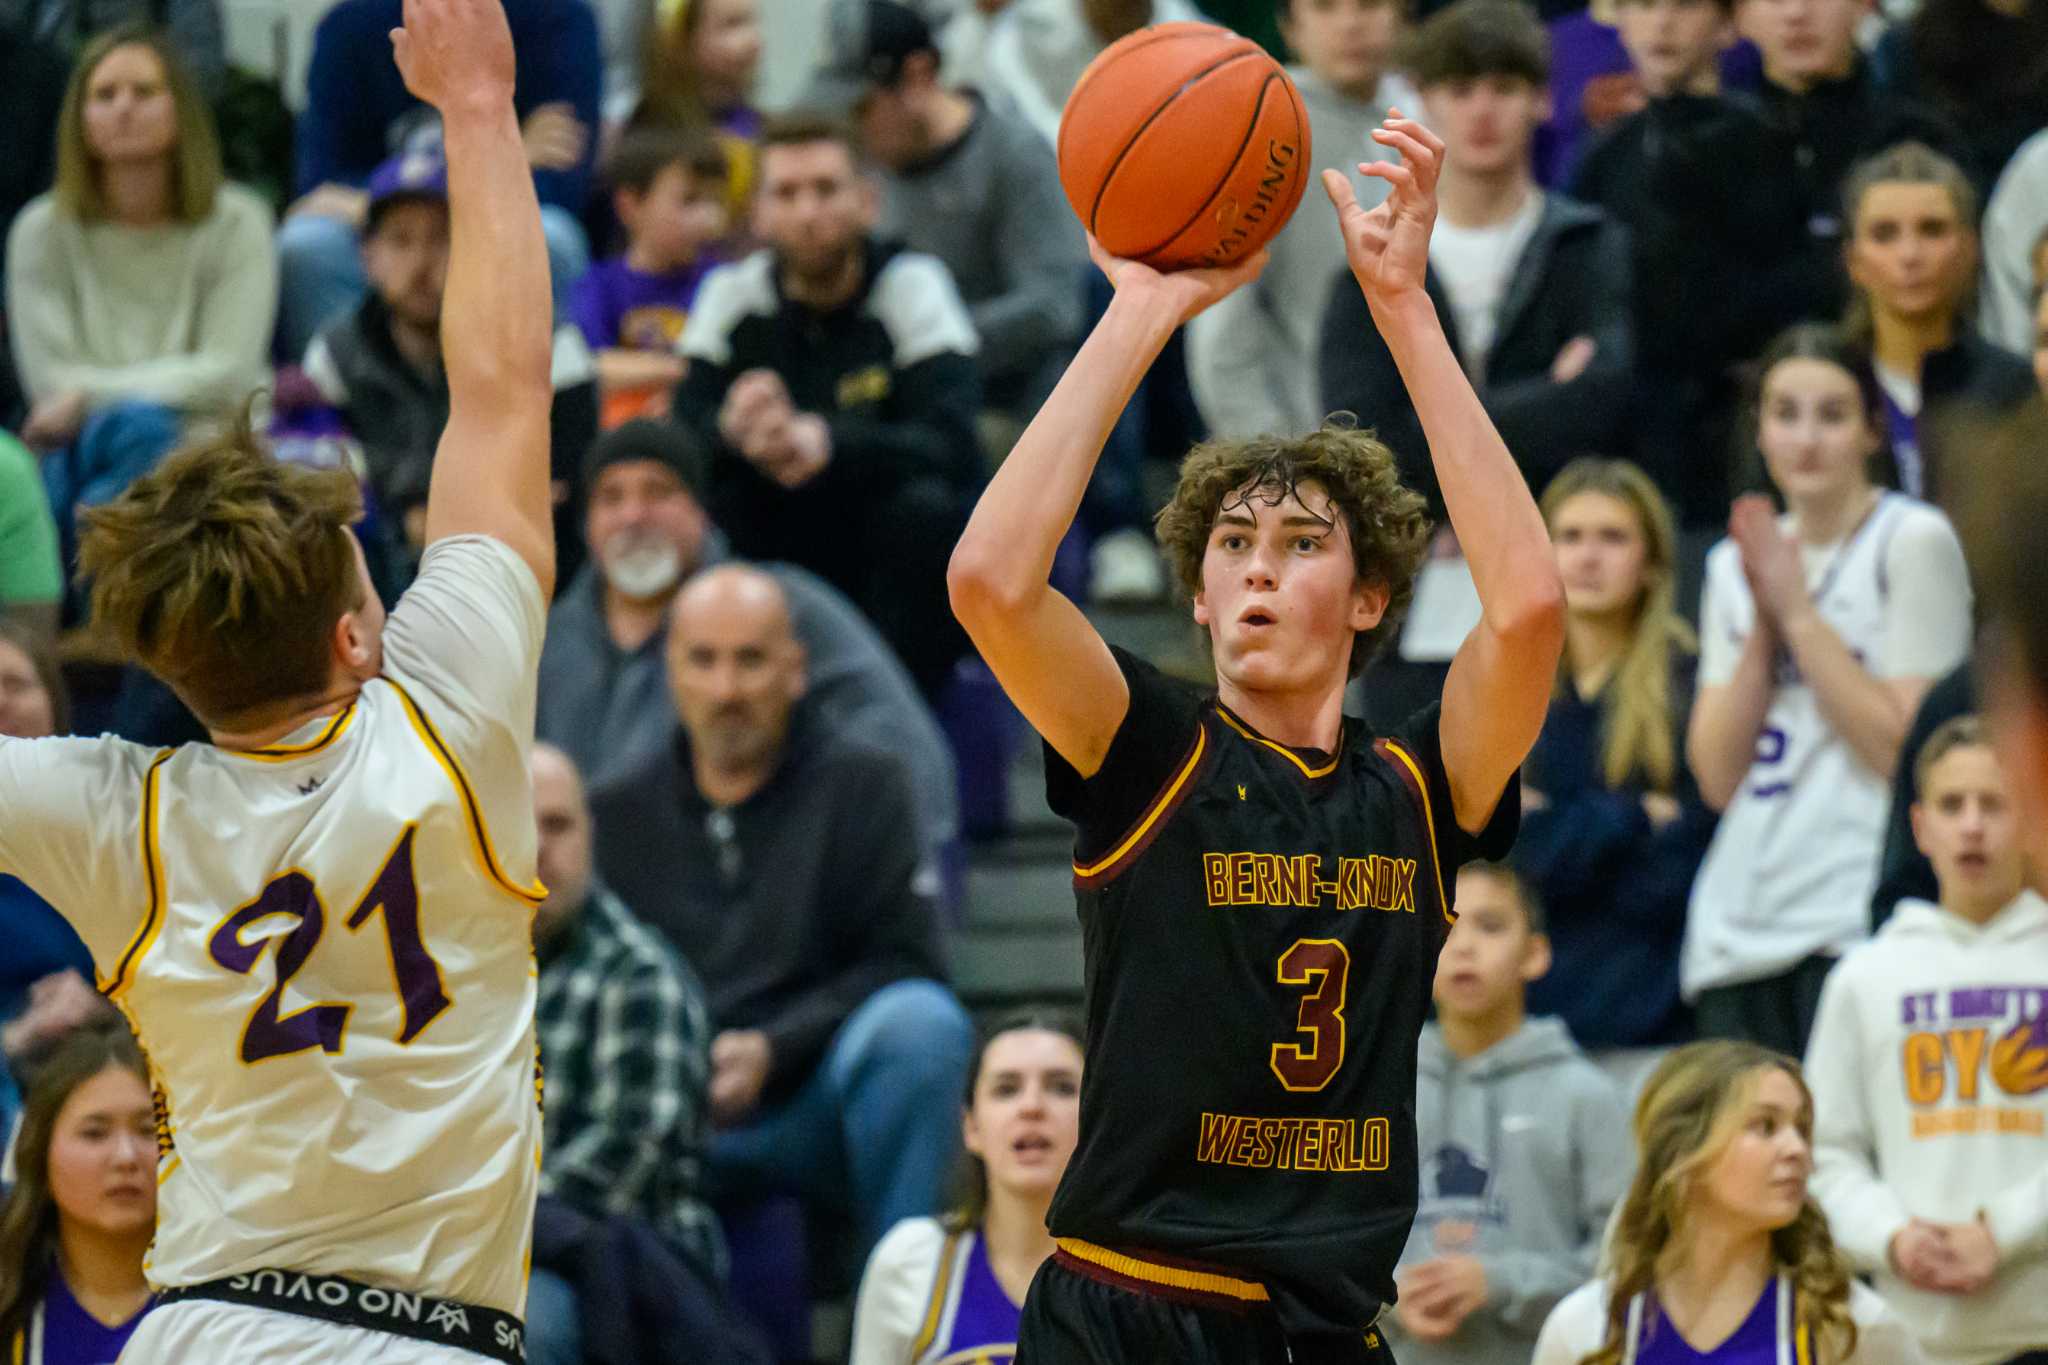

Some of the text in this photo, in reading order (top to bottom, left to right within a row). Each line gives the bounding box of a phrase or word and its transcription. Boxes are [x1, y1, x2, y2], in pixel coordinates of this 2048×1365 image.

[1203, 852, 1416, 914] BERNE-KNOX
[206, 820, 455, 1067] 21
[1270, 938, 1350, 1092] 3
[1198, 1112, 1389, 1171] WESTERLO
